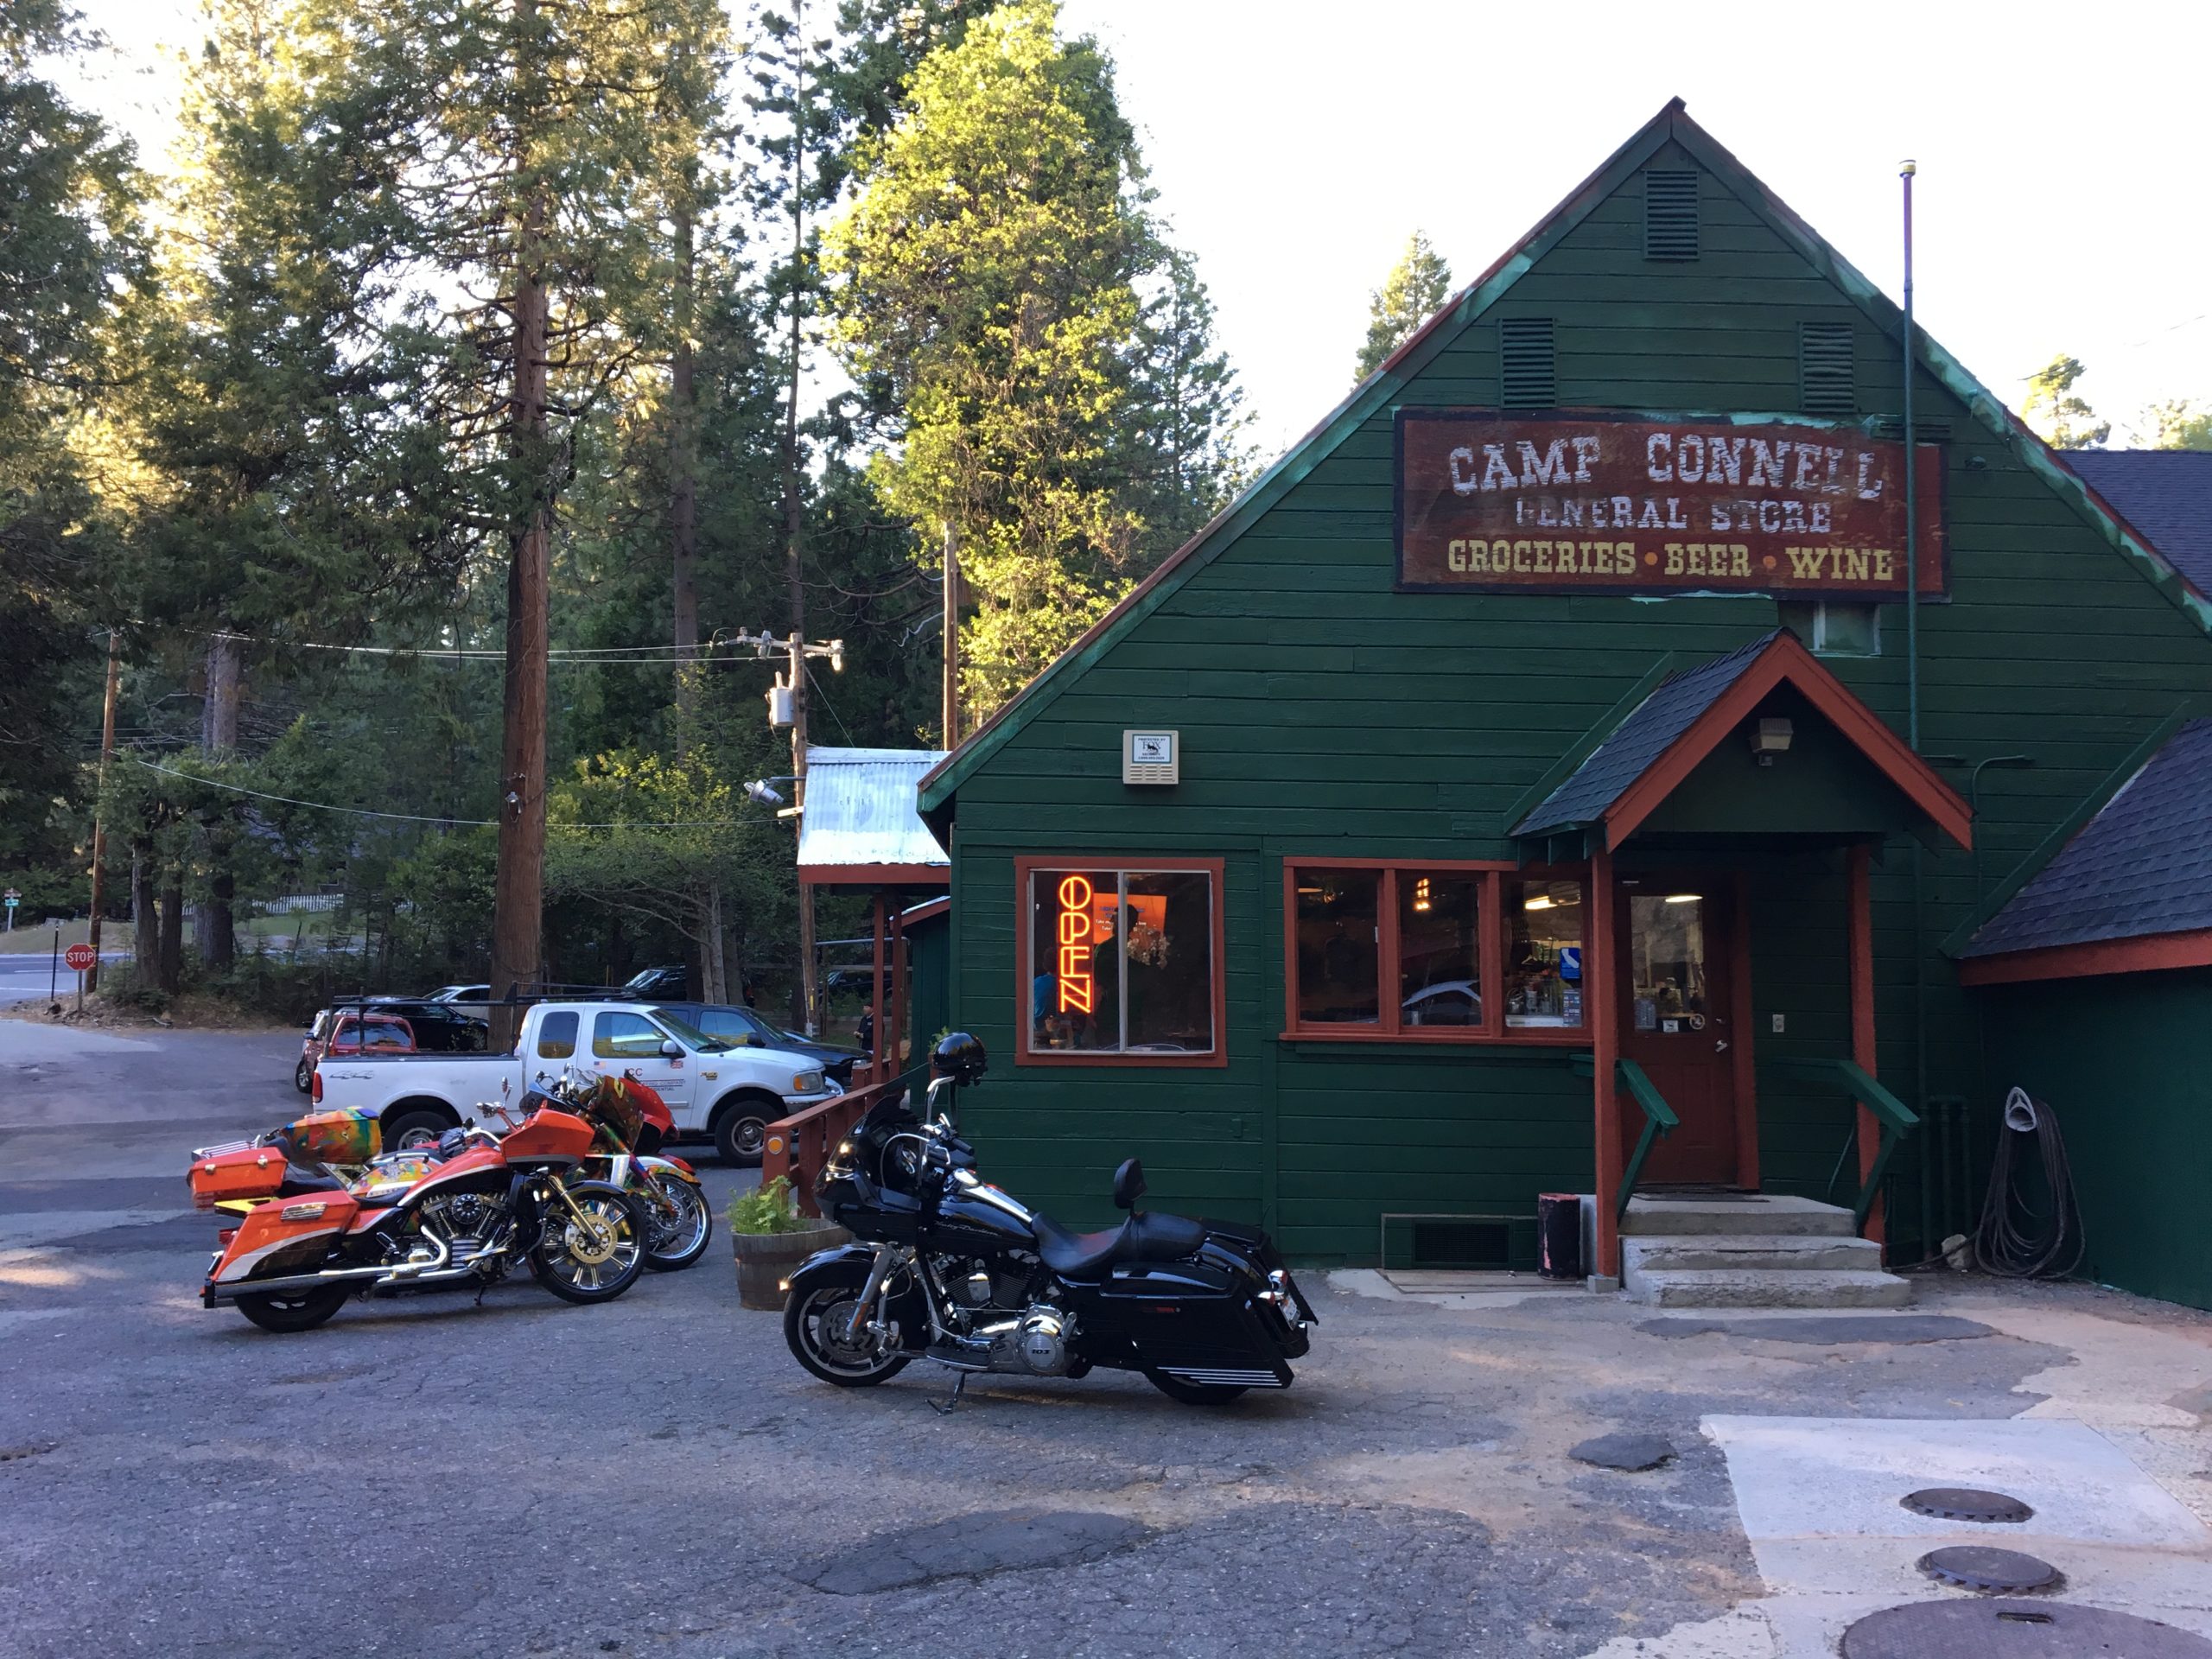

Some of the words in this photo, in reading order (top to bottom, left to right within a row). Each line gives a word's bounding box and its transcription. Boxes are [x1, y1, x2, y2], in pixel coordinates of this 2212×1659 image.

[1450, 435, 1600, 496] CAMP
[1647, 433, 1883, 499] CONNELL
[1448, 539, 1637, 575] GROCERIES
[1664, 543, 1752, 577] BEER
[1784, 546, 1894, 581] WINE
[67, 952, 94, 963] STOP
[1058, 875, 1092, 1014] OPEN
